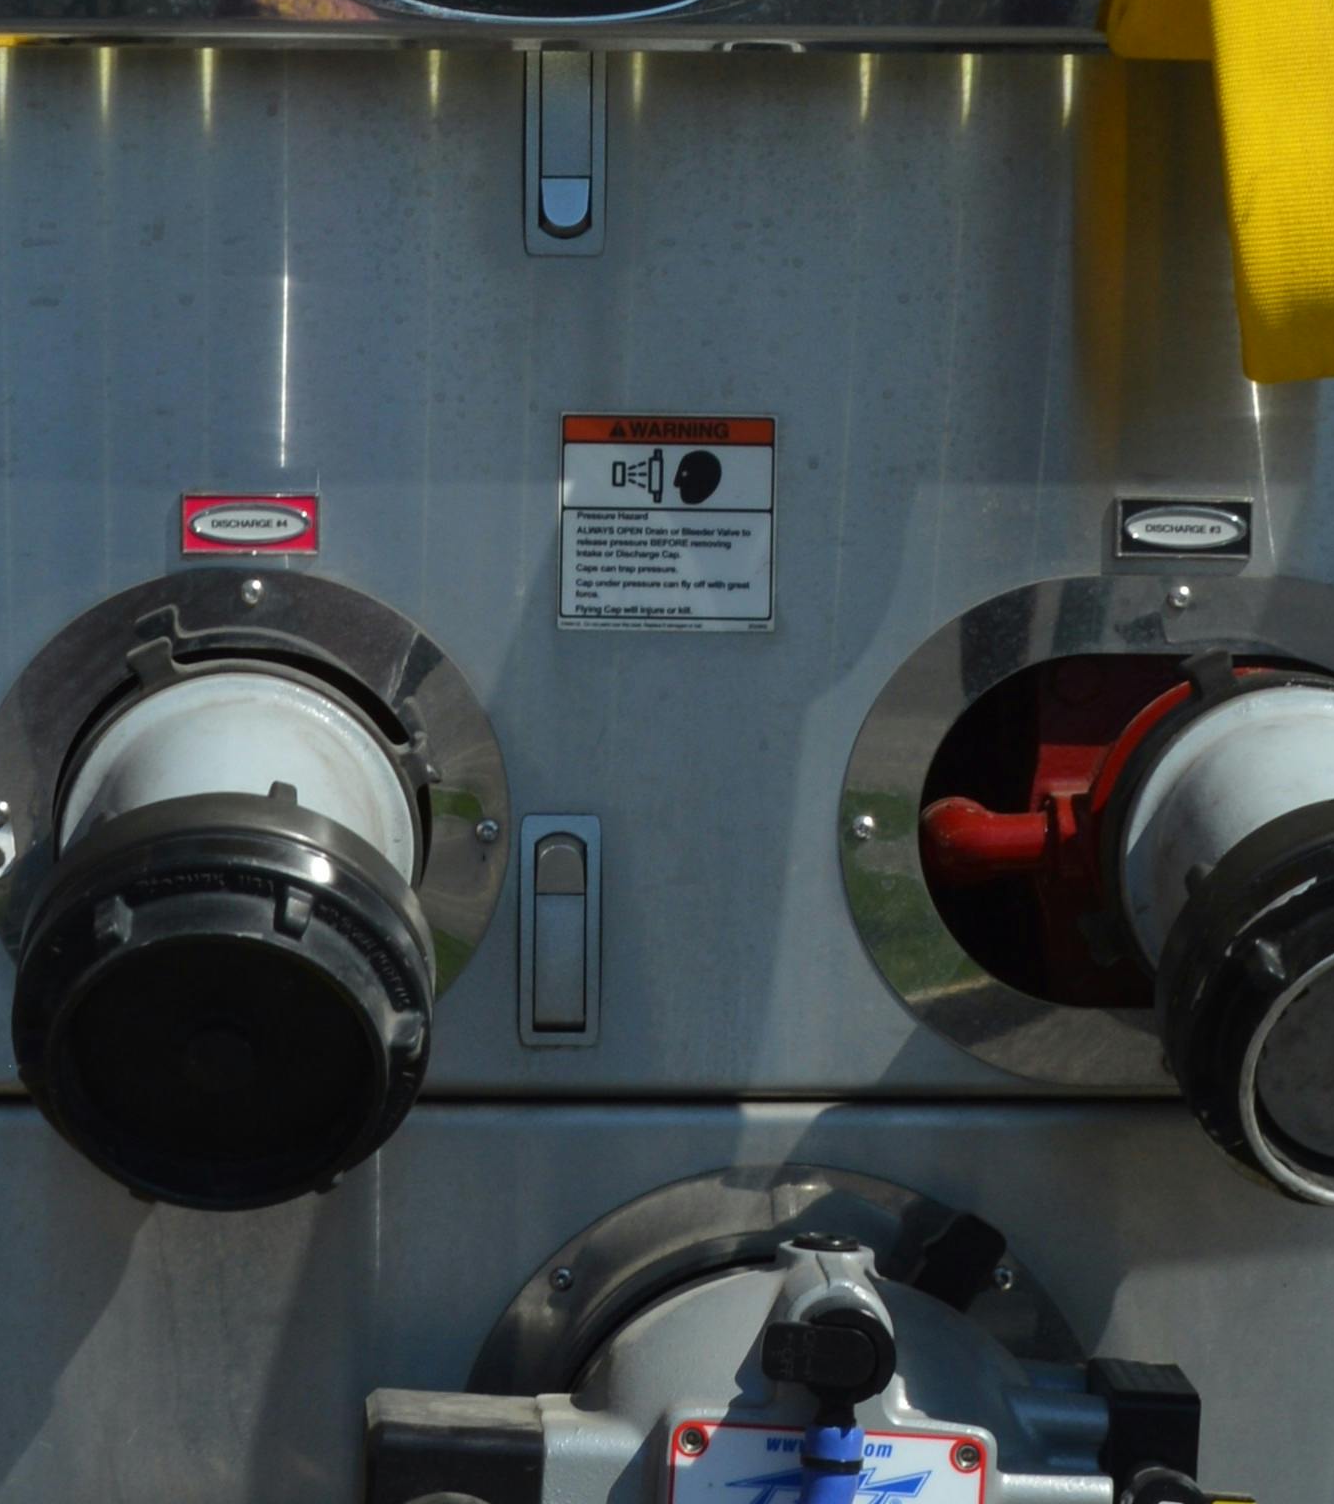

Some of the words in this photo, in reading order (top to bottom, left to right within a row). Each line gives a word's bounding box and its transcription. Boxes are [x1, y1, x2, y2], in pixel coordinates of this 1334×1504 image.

[630, 423, 729, 439] WARNING
[577, 511, 616, 521] Pressure
[618, 512, 649, 521] Hazard
[211, 519, 273, 529] DISCHARGE
[277, 519, 288, 528] #4
[1145, 524, 1206, 534] DISCHARGE
[1210, 525, 1221, 534] #3
[576, 527, 614, 535] ALWAYS
[616, 527, 643, 536] OPEN
[645, 527, 668, 536] Drain
[681, 527, 715, 536] Bleeder
[717, 528, 740, 537] Valve
[741, 528, 751, 537] to
[576, 538, 608, 546] release
[609, 539, 648, 549] pressure
[650, 539, 689, 547] BEFORE
[690, 540, 732, 550] removing
[576, 550, 602, 558] Intake
[604, 550, 614, 558] or
[616, 550, 660, 560] Discharge
[662, 550, 682, 561] Cap.
[576, 564, 598, 574] Caps
[600, 565, 616, 573] can
[618, 565, 636, 575] trap
[637, 565, 678, 575] pressure.
[575, 578, 593, 589] Cap
[595, 579, 621, 588] under
[622, 580, 661, 590] pressure
[663, 581, 679, 589] can
[681, 579, 691, 591] fly
[694, 580, 706, 589] off
[707, 580, 725, 590] with
[727, 581, 750, 591] great
[575, 590, 599, 599] force.
[575, 605, 602, 616] Flying
[604, 605, 621, 616] Cap
[623, 605, 638, 614] will
[640, 606, 665, 616] injure
[667, 606, 676, 615] or
[678, 606, 693, 615] kill.
